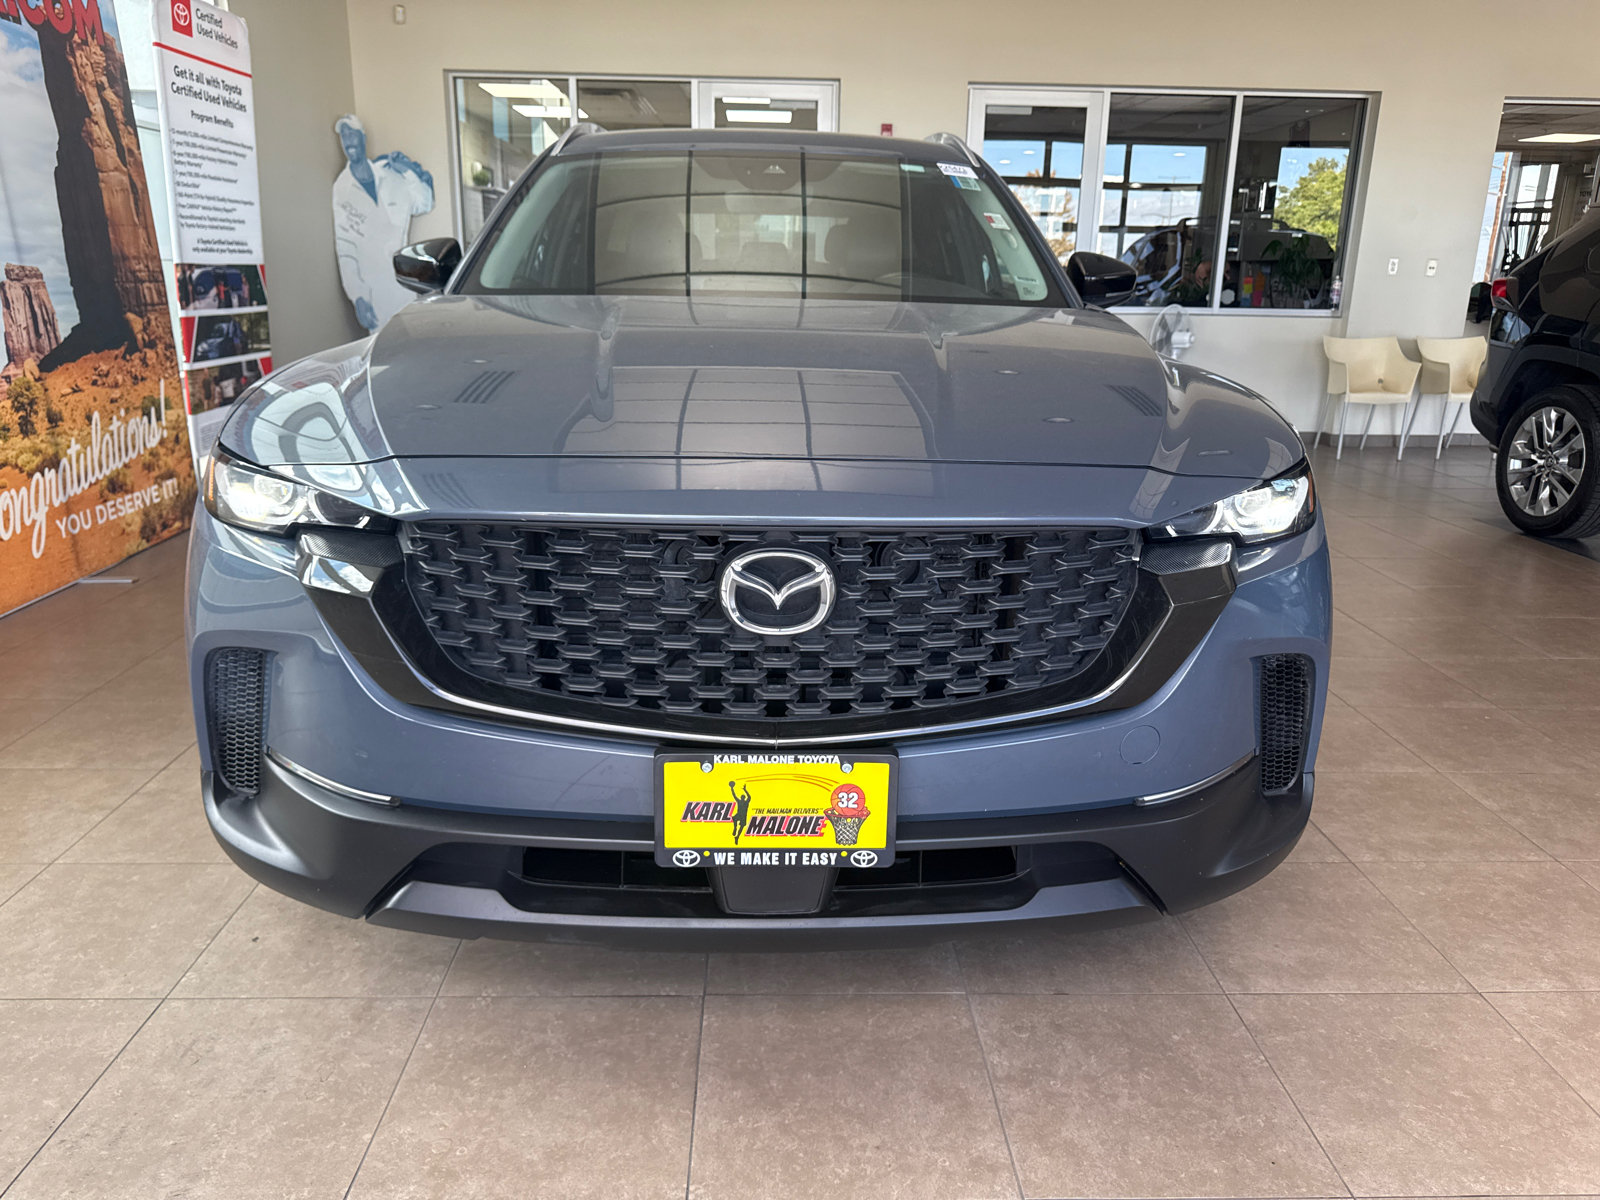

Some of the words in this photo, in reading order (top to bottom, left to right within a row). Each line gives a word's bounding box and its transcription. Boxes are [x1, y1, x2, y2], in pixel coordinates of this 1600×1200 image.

[195, 8, 222, 28] Certified
[196, 22, 213, 39] Used
[213, 29, 238, 49] Vehicles
[173, 65, 188, 80] Get
[188, 69, 195, 82] it
[195, 71, 205, 85] all
[205, 75, 221, 90] with
[221, 79, 242, 96] Toyota
[171, 81, 203, 101] Certified
[203, 90, 221, 106] Used
[221, 95, 247, 113] Vehicles
[190, 109, 213, 123] Program
[213, 115, 234, 129] Benefits
[0, 378, 168, 559] ongratulations!
[55, 507, 92, 538] YOU
[95, 483, 161, 525] DESERVE
[162, 477, 179, 500] IT!
[713, 754, 744, 764] KARL
[748, 755, 795, 764] MALONE
[797, 755, 840, 764] TOYOTA
[837, 792, 859, 808] 32
[680, 801, 736, 823] KARL
[744, 815, 829, 837] MALONE
[713, 852, 735, 865] WE
[740, 852, 780, 866] MAKE
[784, 852, 798, 866] IT
[802, 852, 837, 866] EASY
